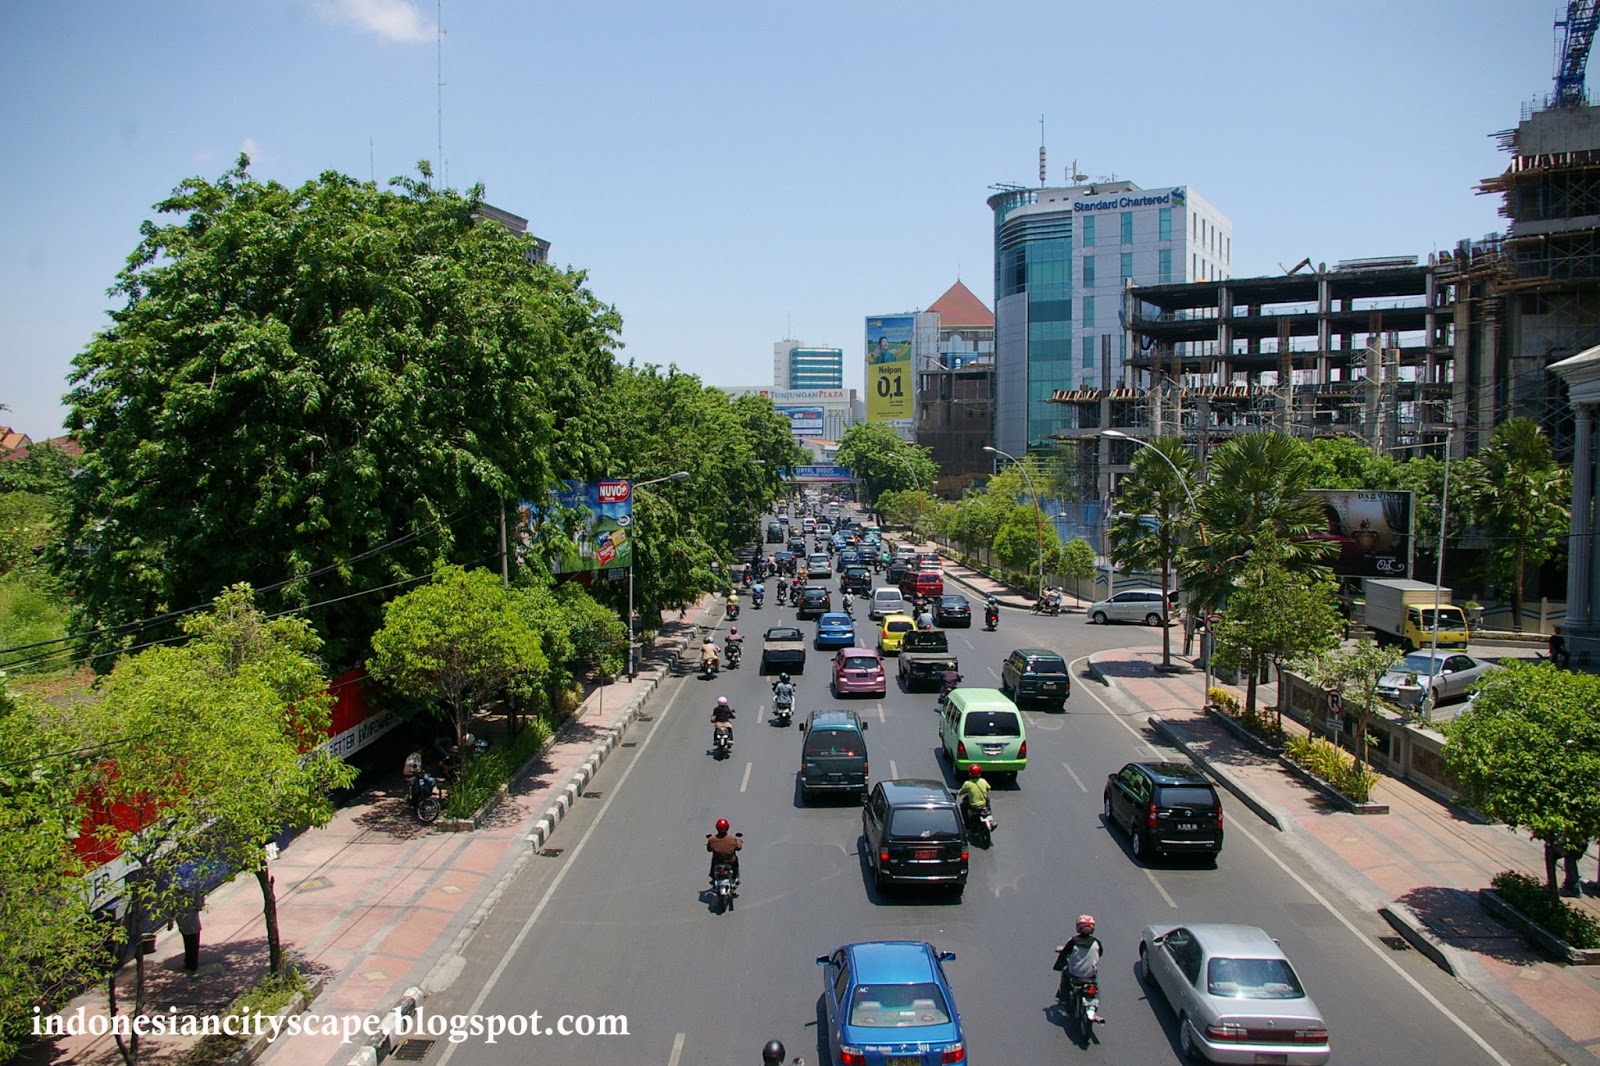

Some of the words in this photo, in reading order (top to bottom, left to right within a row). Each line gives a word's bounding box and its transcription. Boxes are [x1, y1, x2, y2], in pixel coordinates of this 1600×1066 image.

[1074, 198, 1118, 212] Standard
[1120, 193, 1170, 207] Chartered
[879, 366, 902, 375] Nelpon
[819, 390, 844, 398] PLAZA
[877, 376, 904, 400] 0,1
[600, 485, 622, 497] NUVO
